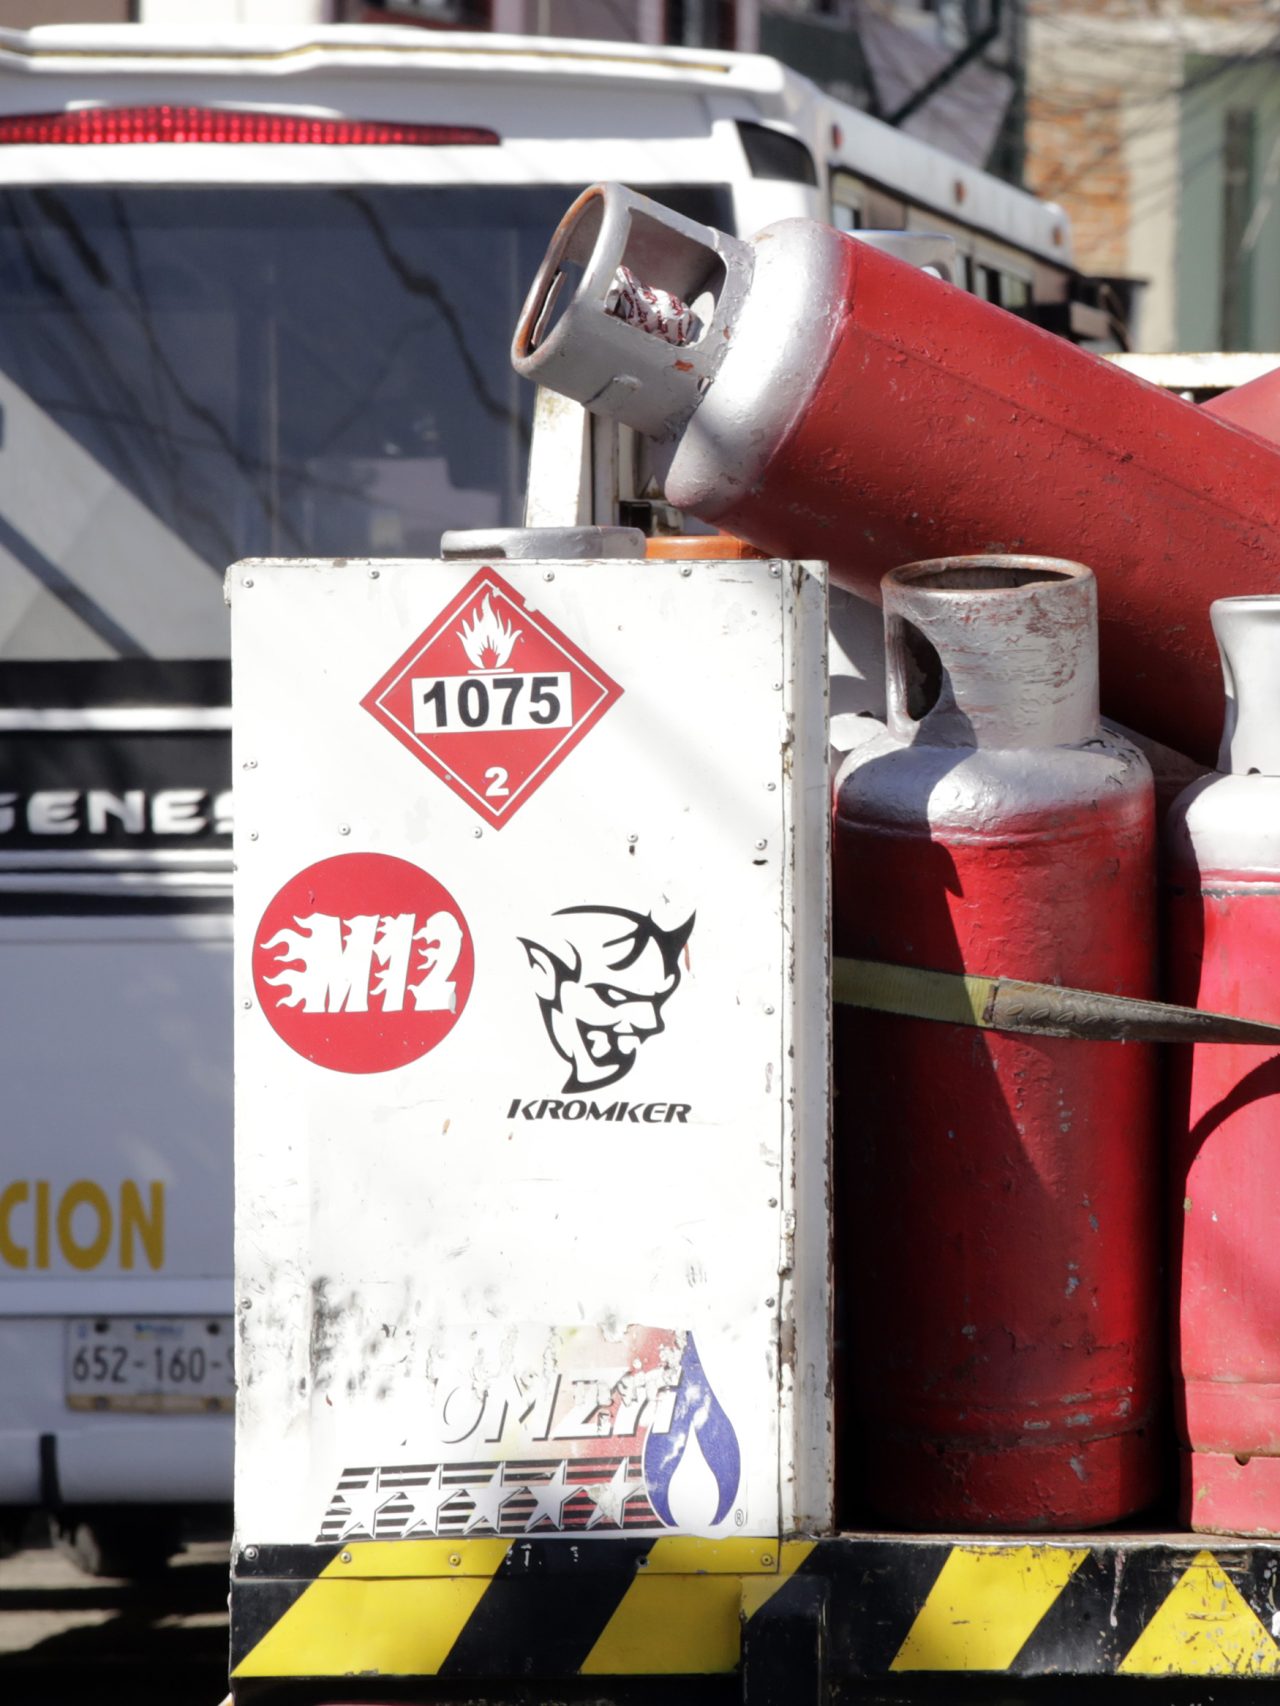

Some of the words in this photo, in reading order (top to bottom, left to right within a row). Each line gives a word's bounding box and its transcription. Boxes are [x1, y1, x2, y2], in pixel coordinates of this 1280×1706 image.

[423, 676, 561, 728] 1075
[484, 766, 510, 797] 2
[260, 910, 463, 1014] M12
[506, 1098, 692, 1123] KROMKER
[0, 1178, 165, 1272] CION
